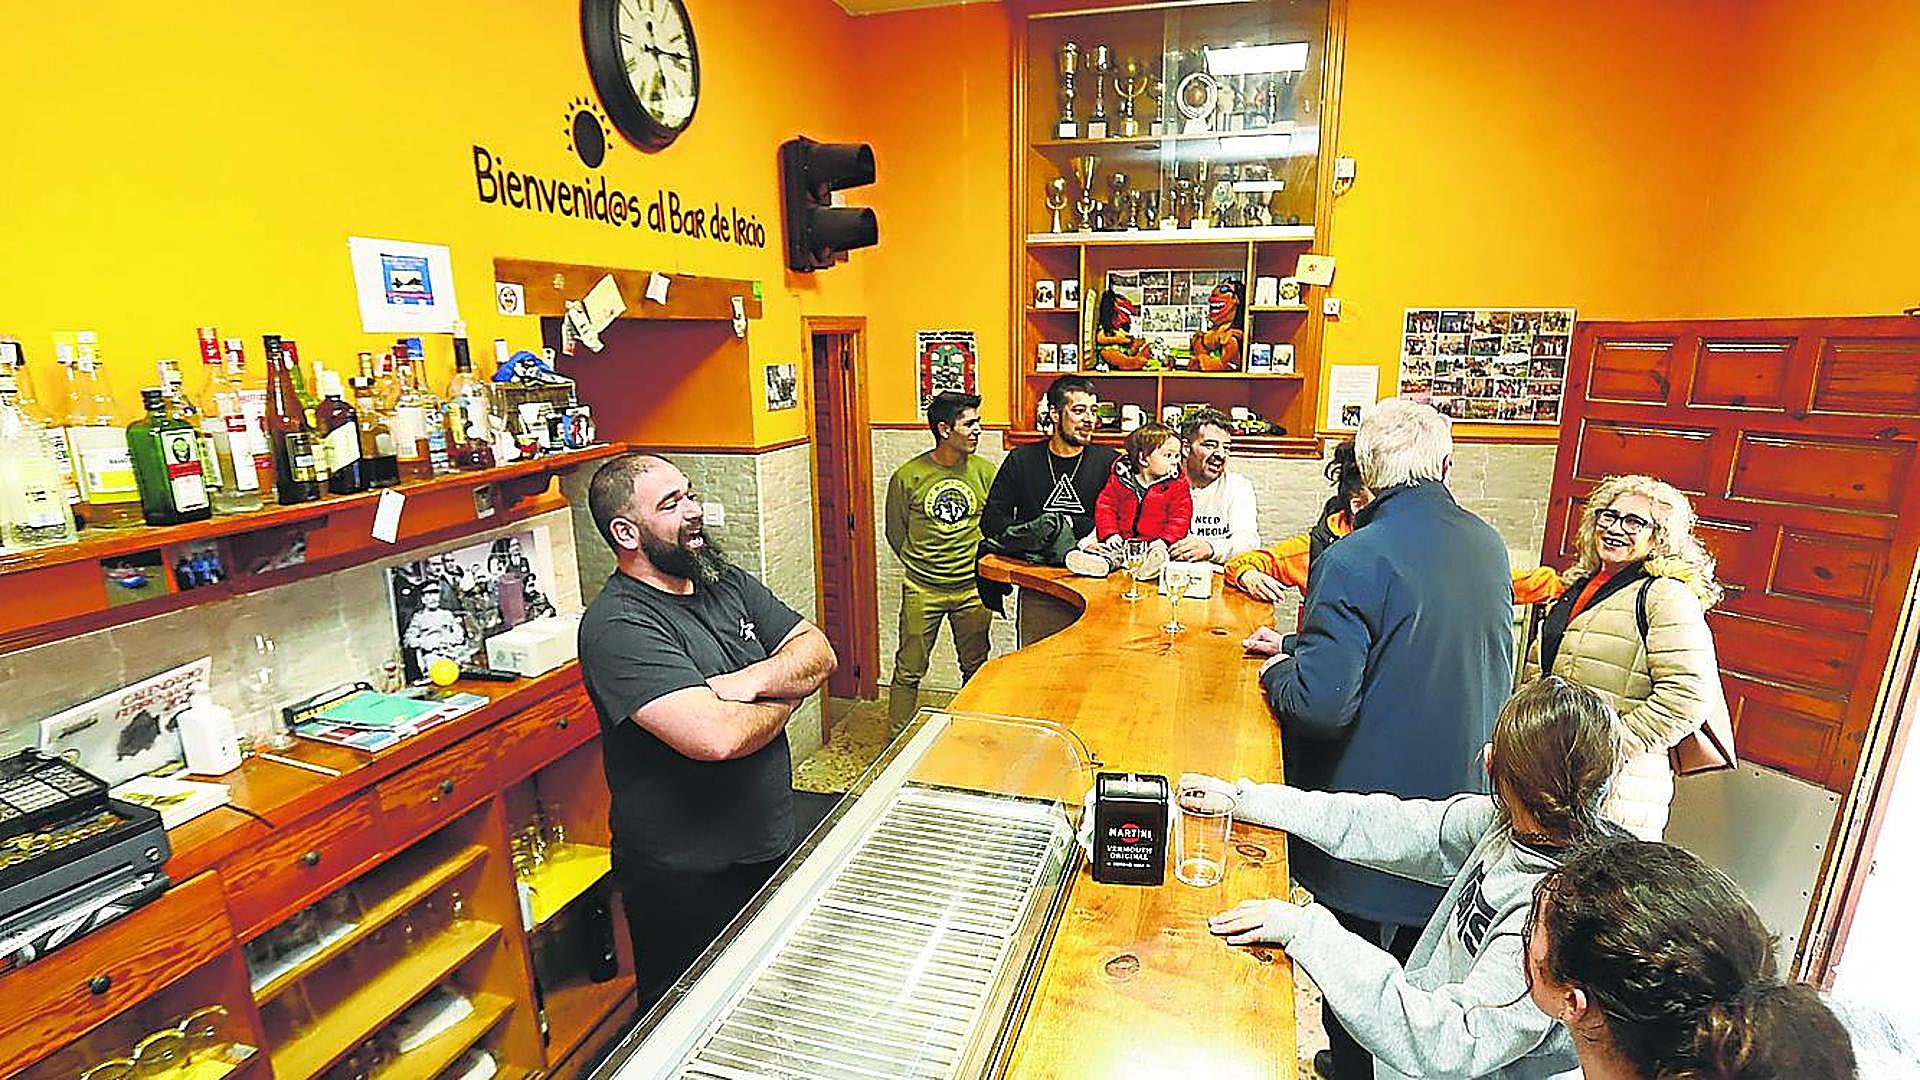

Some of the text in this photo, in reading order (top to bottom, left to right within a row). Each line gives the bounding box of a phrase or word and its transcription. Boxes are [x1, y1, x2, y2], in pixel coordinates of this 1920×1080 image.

[473, 145, 641, 228] Bienvenid@s
[648, 190, 666, 232] al
[710, 202, 731, 243] de
[1108, 827, 1152, 840] MARTINI
